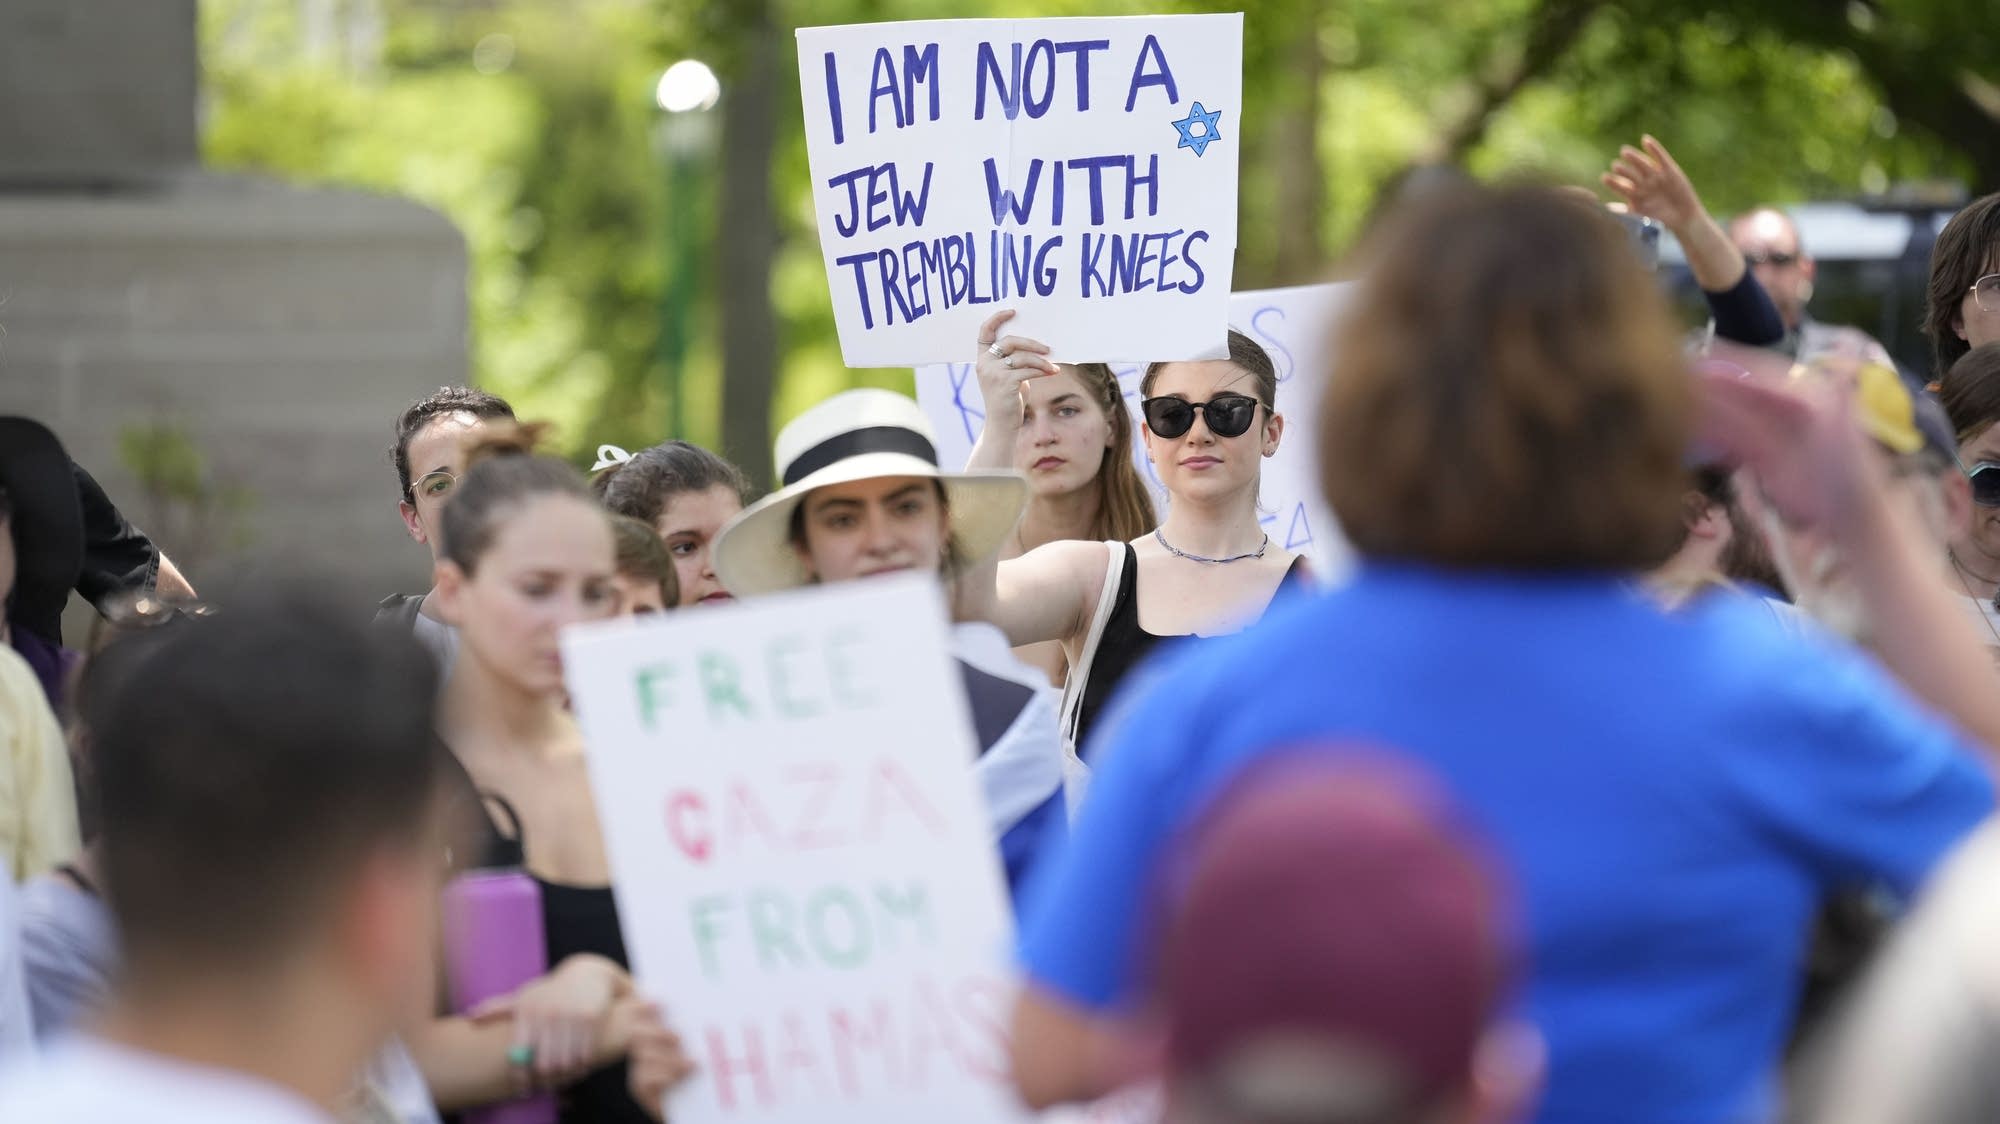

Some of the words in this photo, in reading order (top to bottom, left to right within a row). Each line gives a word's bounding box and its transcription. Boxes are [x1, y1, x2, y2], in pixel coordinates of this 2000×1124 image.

[824, 52, 844, 144] I
[869, 43, 940, 133] AM
[974, 38, 1110, 120] NOT
[1125, 34, 1179, 112] A
[828, 162, 934, 238] JEW
[983, 153, 1158, 226] WITH
[836, 229, 1063, 330] TREMBLING
[1081, 229, 1209, 299] KNEES
[632, 621, 879, 732] FREE
[687, 880, 940, 978] FROM
